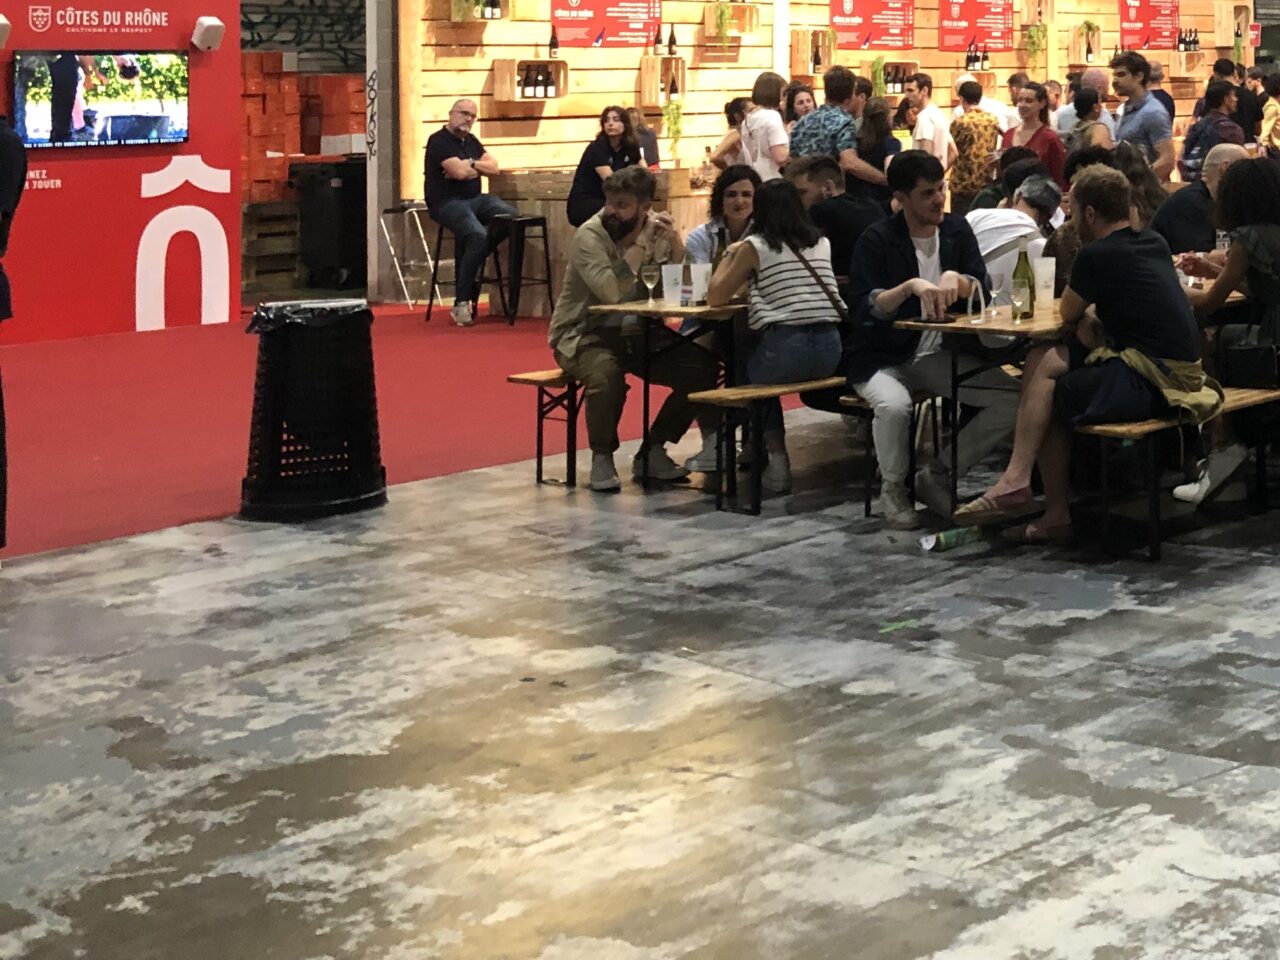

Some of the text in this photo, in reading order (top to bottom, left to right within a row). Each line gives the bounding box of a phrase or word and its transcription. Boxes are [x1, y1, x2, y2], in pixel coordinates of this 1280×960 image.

[56, 7, 168, 26] CÔTES DU RHÔNE
[33, 179, 62, 189] JOUER
